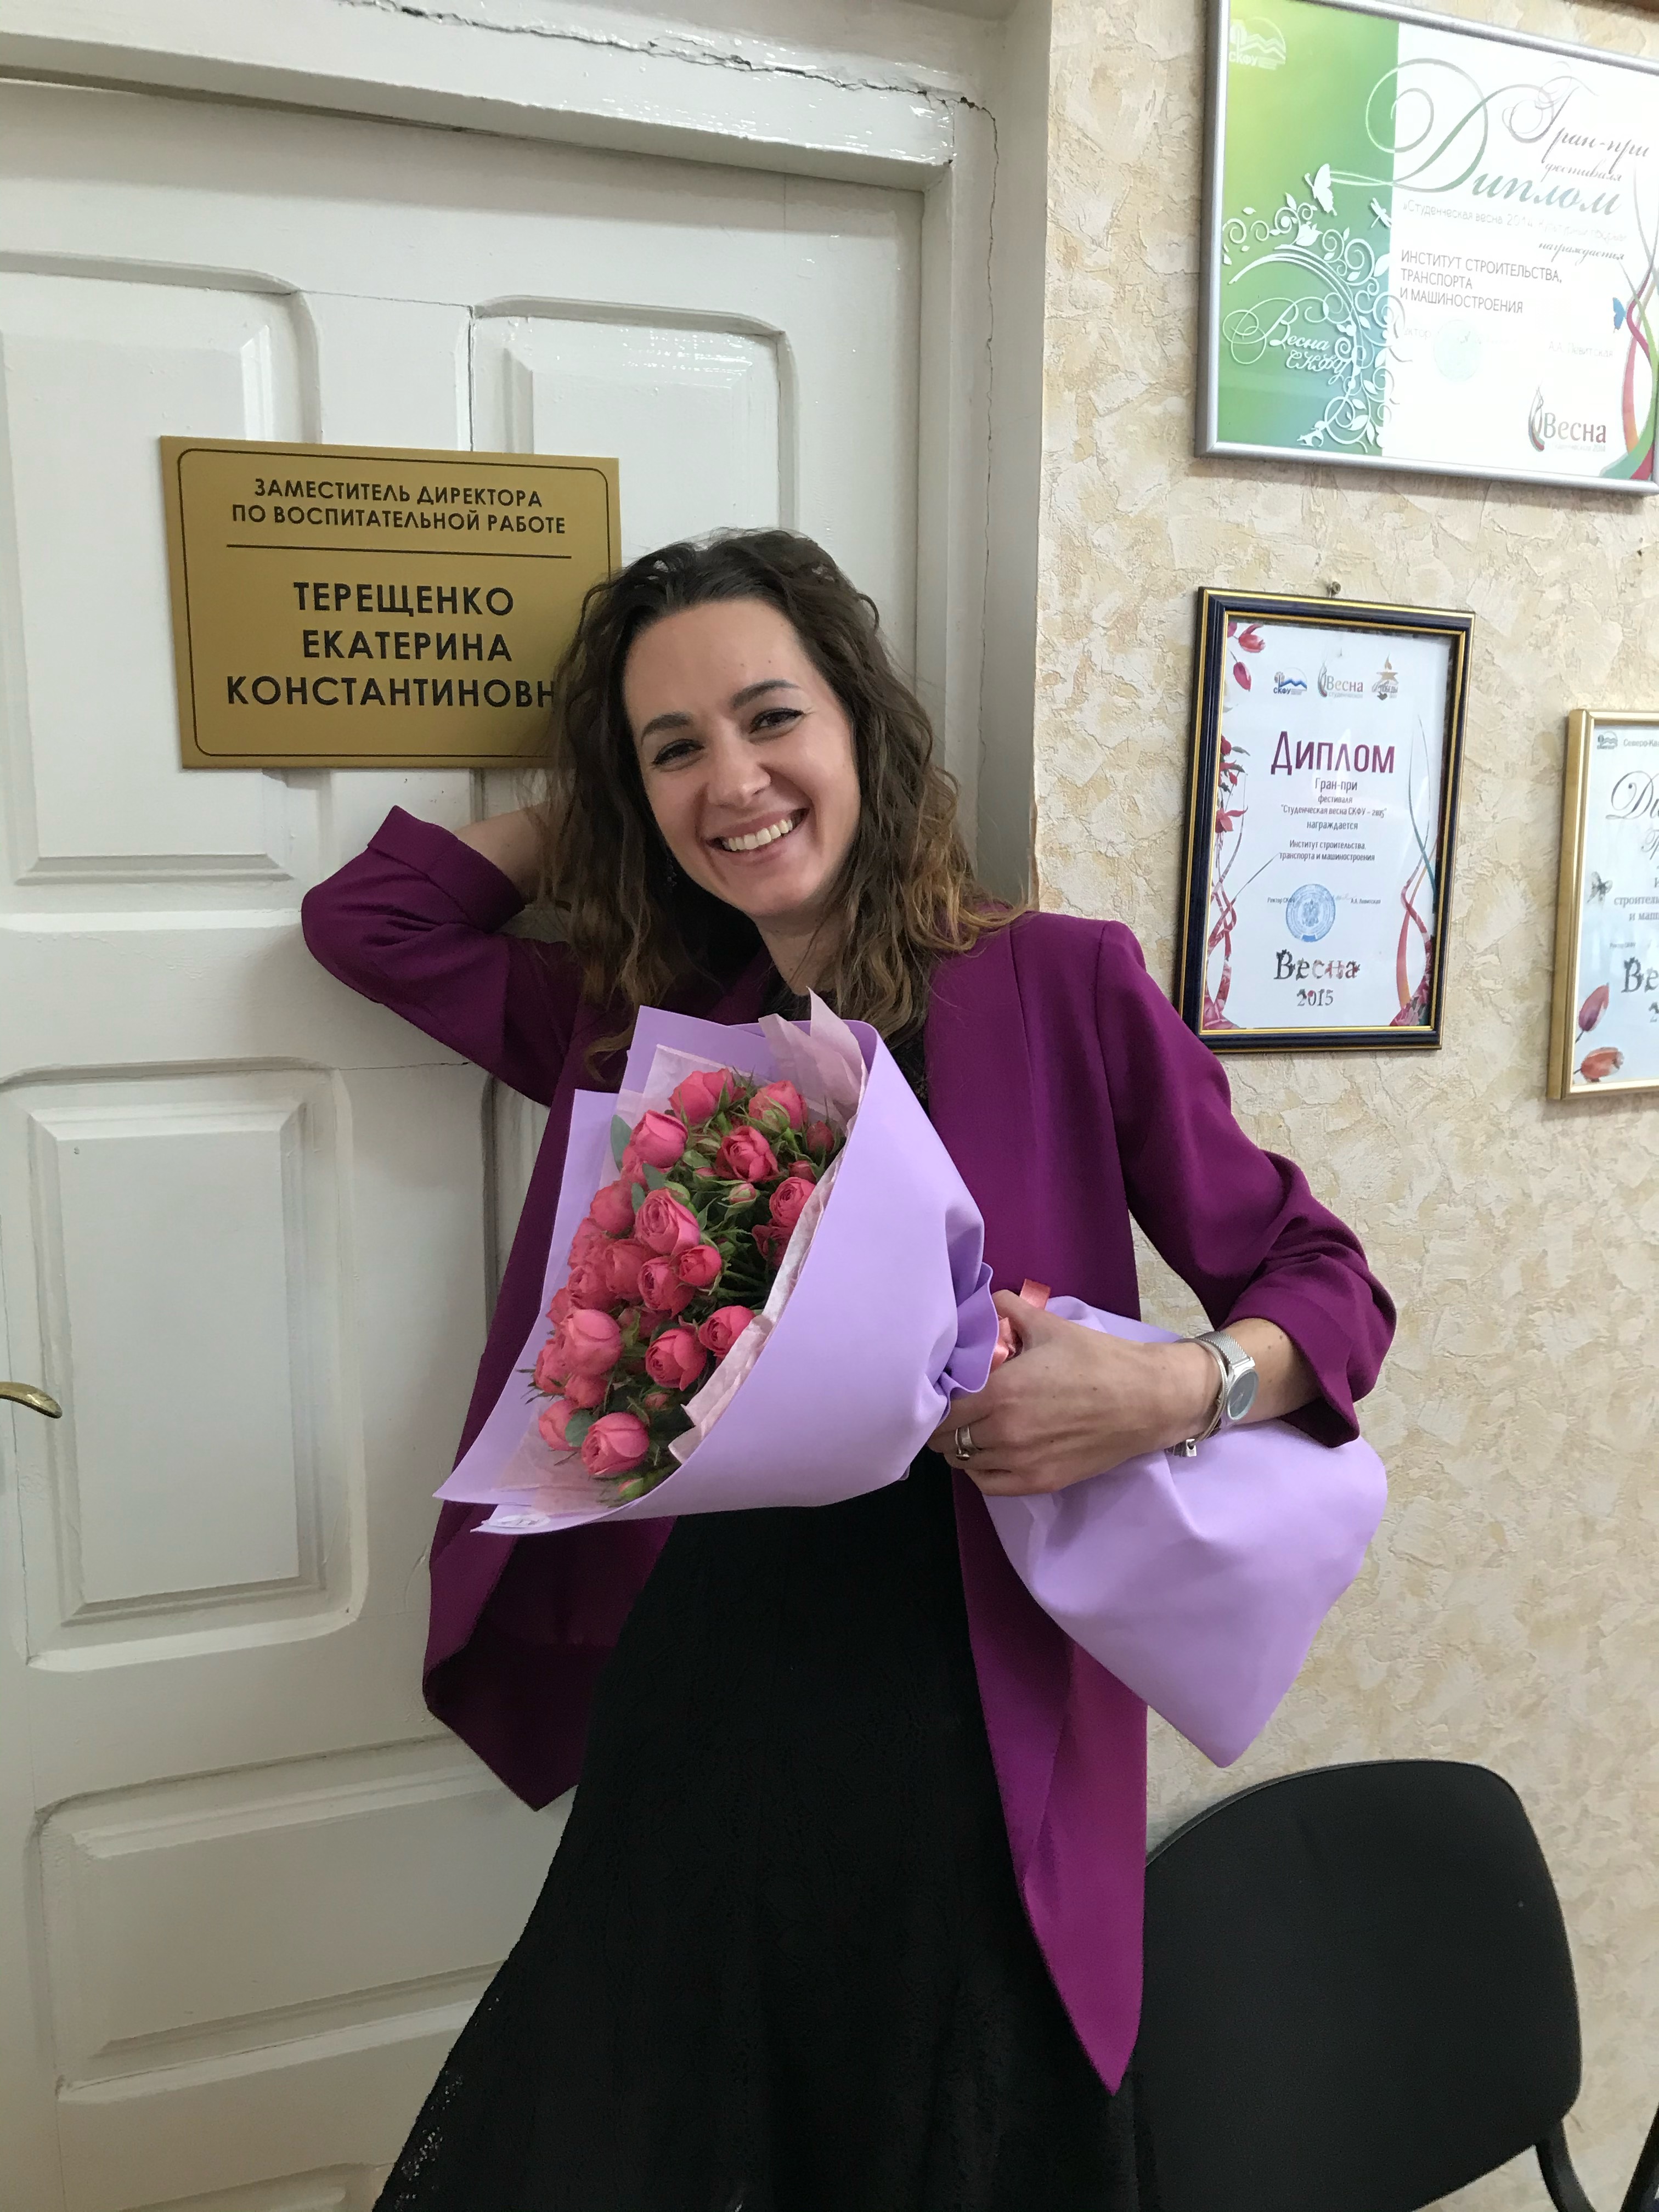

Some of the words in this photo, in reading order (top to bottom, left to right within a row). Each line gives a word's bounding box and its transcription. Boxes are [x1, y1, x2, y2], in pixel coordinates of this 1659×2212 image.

[1502, 63, 1650, 175] Гран-при
[1365, 58, 1622, 216] Диплом
[1541, 158, 1622, 183] фестиваля
[1401, 249, 1462, 269] ИНСТИТУТ
[1465, 258, 1562, 284] СТРОИТЕЛЬСТВА,
[1538, 242, 1625, 267] награждается
[1400, 268, 1472, 290] ТРАНСПОРТА
[1400, 287, 1408, 300] И
[1411, 289, 1523, 314] МАШИНОСТРОЕНИЯ
[1543, 412, 1606, 444] Весна
[255, 477, 410, 503] ЗАМЕСТИТЕЛЬ
[417, 486, 543, 508] ДИРЕКТОРА
[233, 504, 266, 523] ПО
[274, 505, 479, 532] ВОСПИТАТЕЛЬНОЙ
[488, 514, 566, 534] РАБОТЕ
[294, 582, 514, 617] ТЕРЕЩЕНКО
[303, 629, 512, 662] ЕКАТЕРИНА
[227, 675, 555, 708] КОНСТАНТИНОВН
[1327, 675, 1364, 692] Весна
[1315, 777, 1358, 793] Гран-при
[1318, 794, 1353, 804] фестиваля
[1329, 807, 1347, 815] весна
[1348, 807, 1366, 816] СКФУ
[1307, 821, 1358, 831] награждается
[1279, 852, 1315, 862] транспорта
[1322, 853, 1375, 862] машиностроения
[1289, 840, 1318, 850] Институт
[1273, 949, 1361, 981] Весна
[1296, 989, 1334, 1006] 2015
